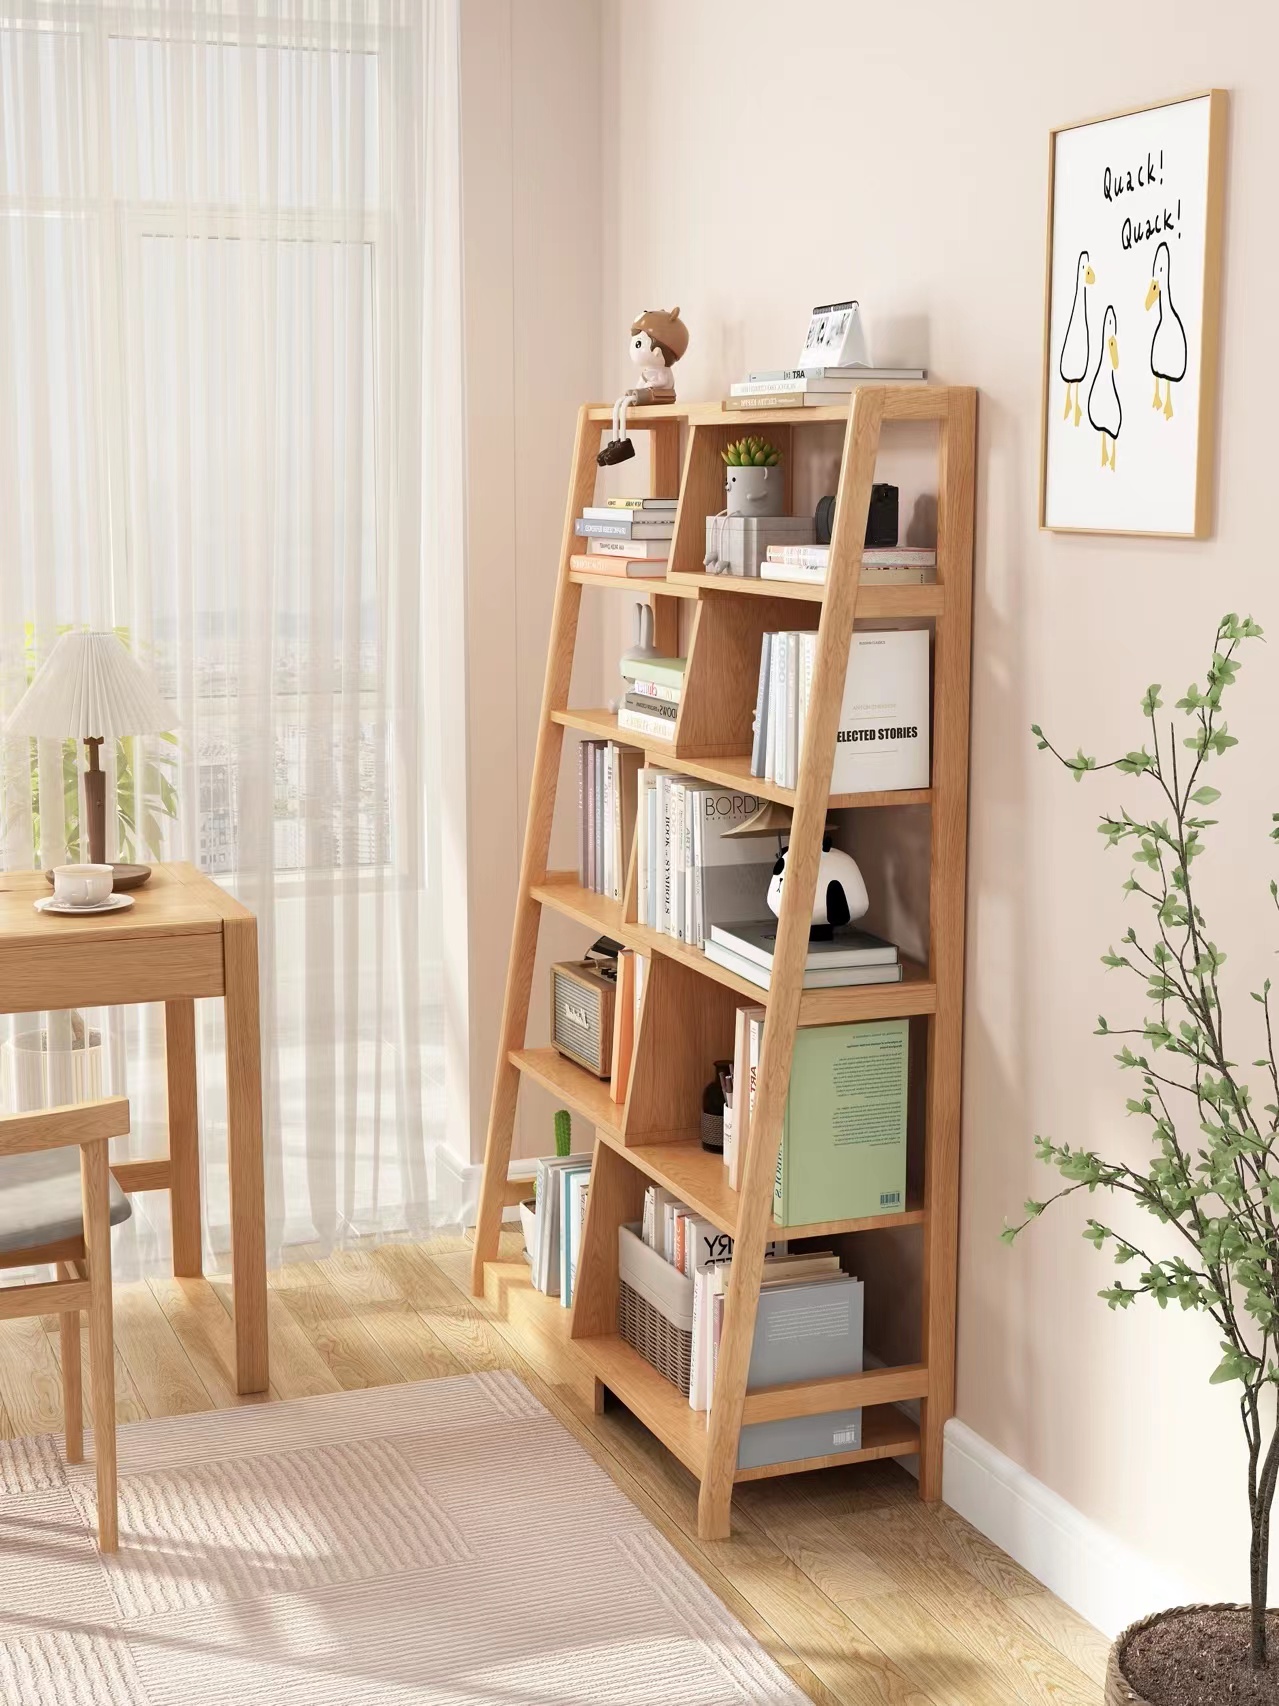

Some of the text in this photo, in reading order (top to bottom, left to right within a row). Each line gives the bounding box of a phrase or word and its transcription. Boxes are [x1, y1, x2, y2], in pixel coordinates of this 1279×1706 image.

[1103, 149, 1163, 202] Quack!
[1121, 199, 1181, 250] Quack!
[836, 726, 918, 743] ELECTED STORIES
